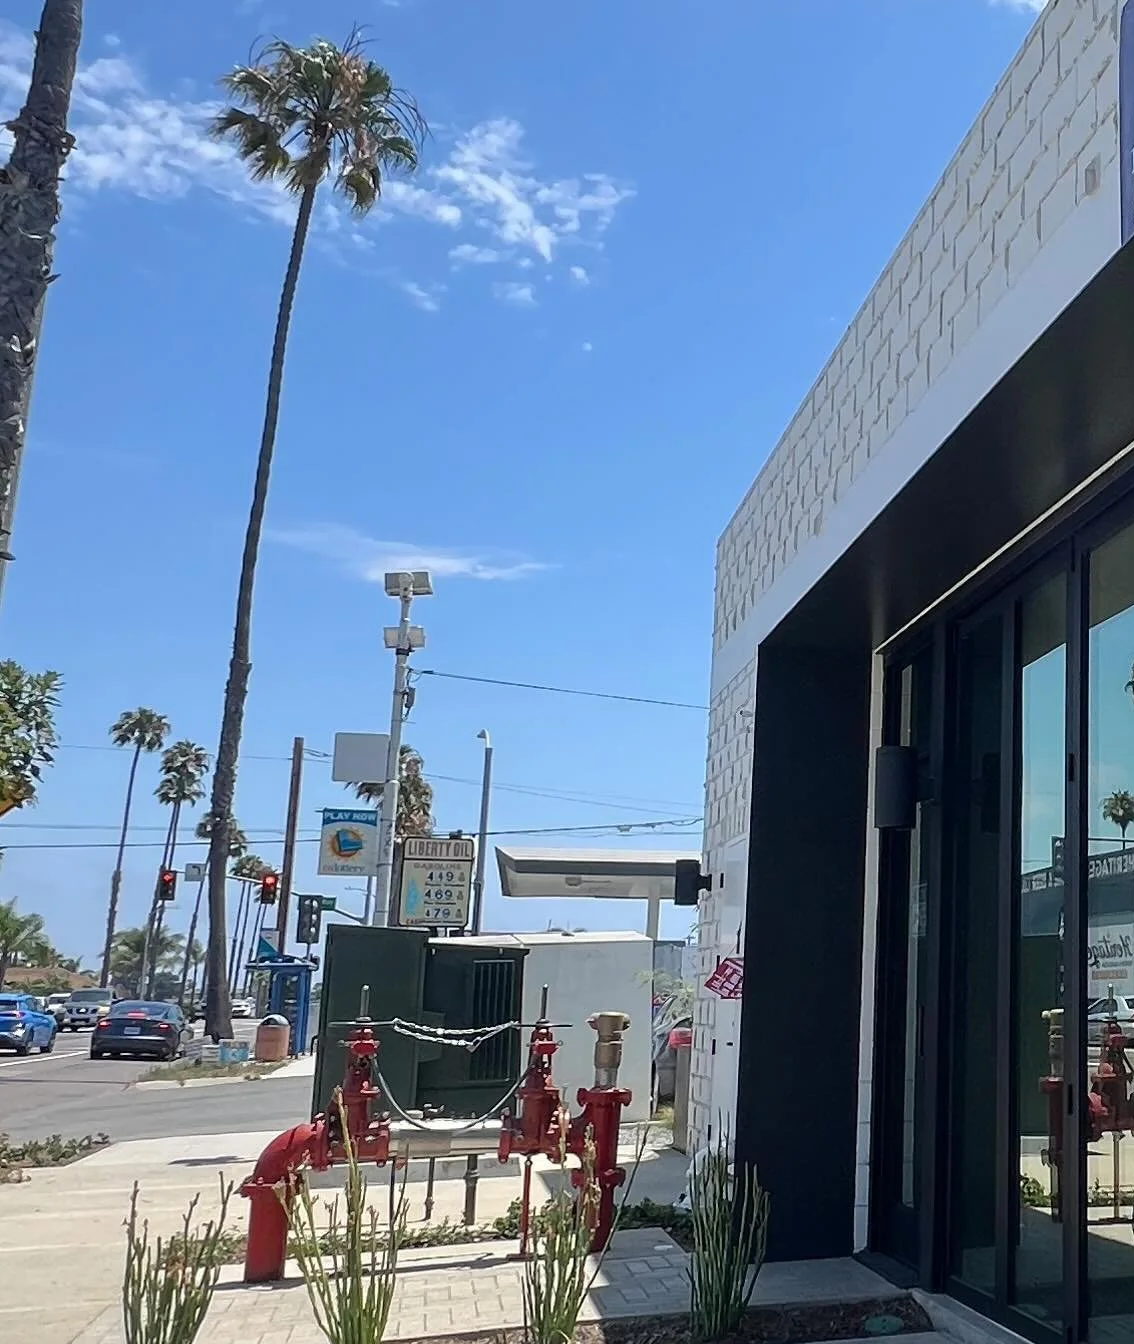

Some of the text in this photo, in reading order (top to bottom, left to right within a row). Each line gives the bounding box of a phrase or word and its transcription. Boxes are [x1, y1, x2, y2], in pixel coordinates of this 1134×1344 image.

[324, 811, 377, 821] PLAY NOW
[408, 840, 470, 857] LIBERTY OIL
